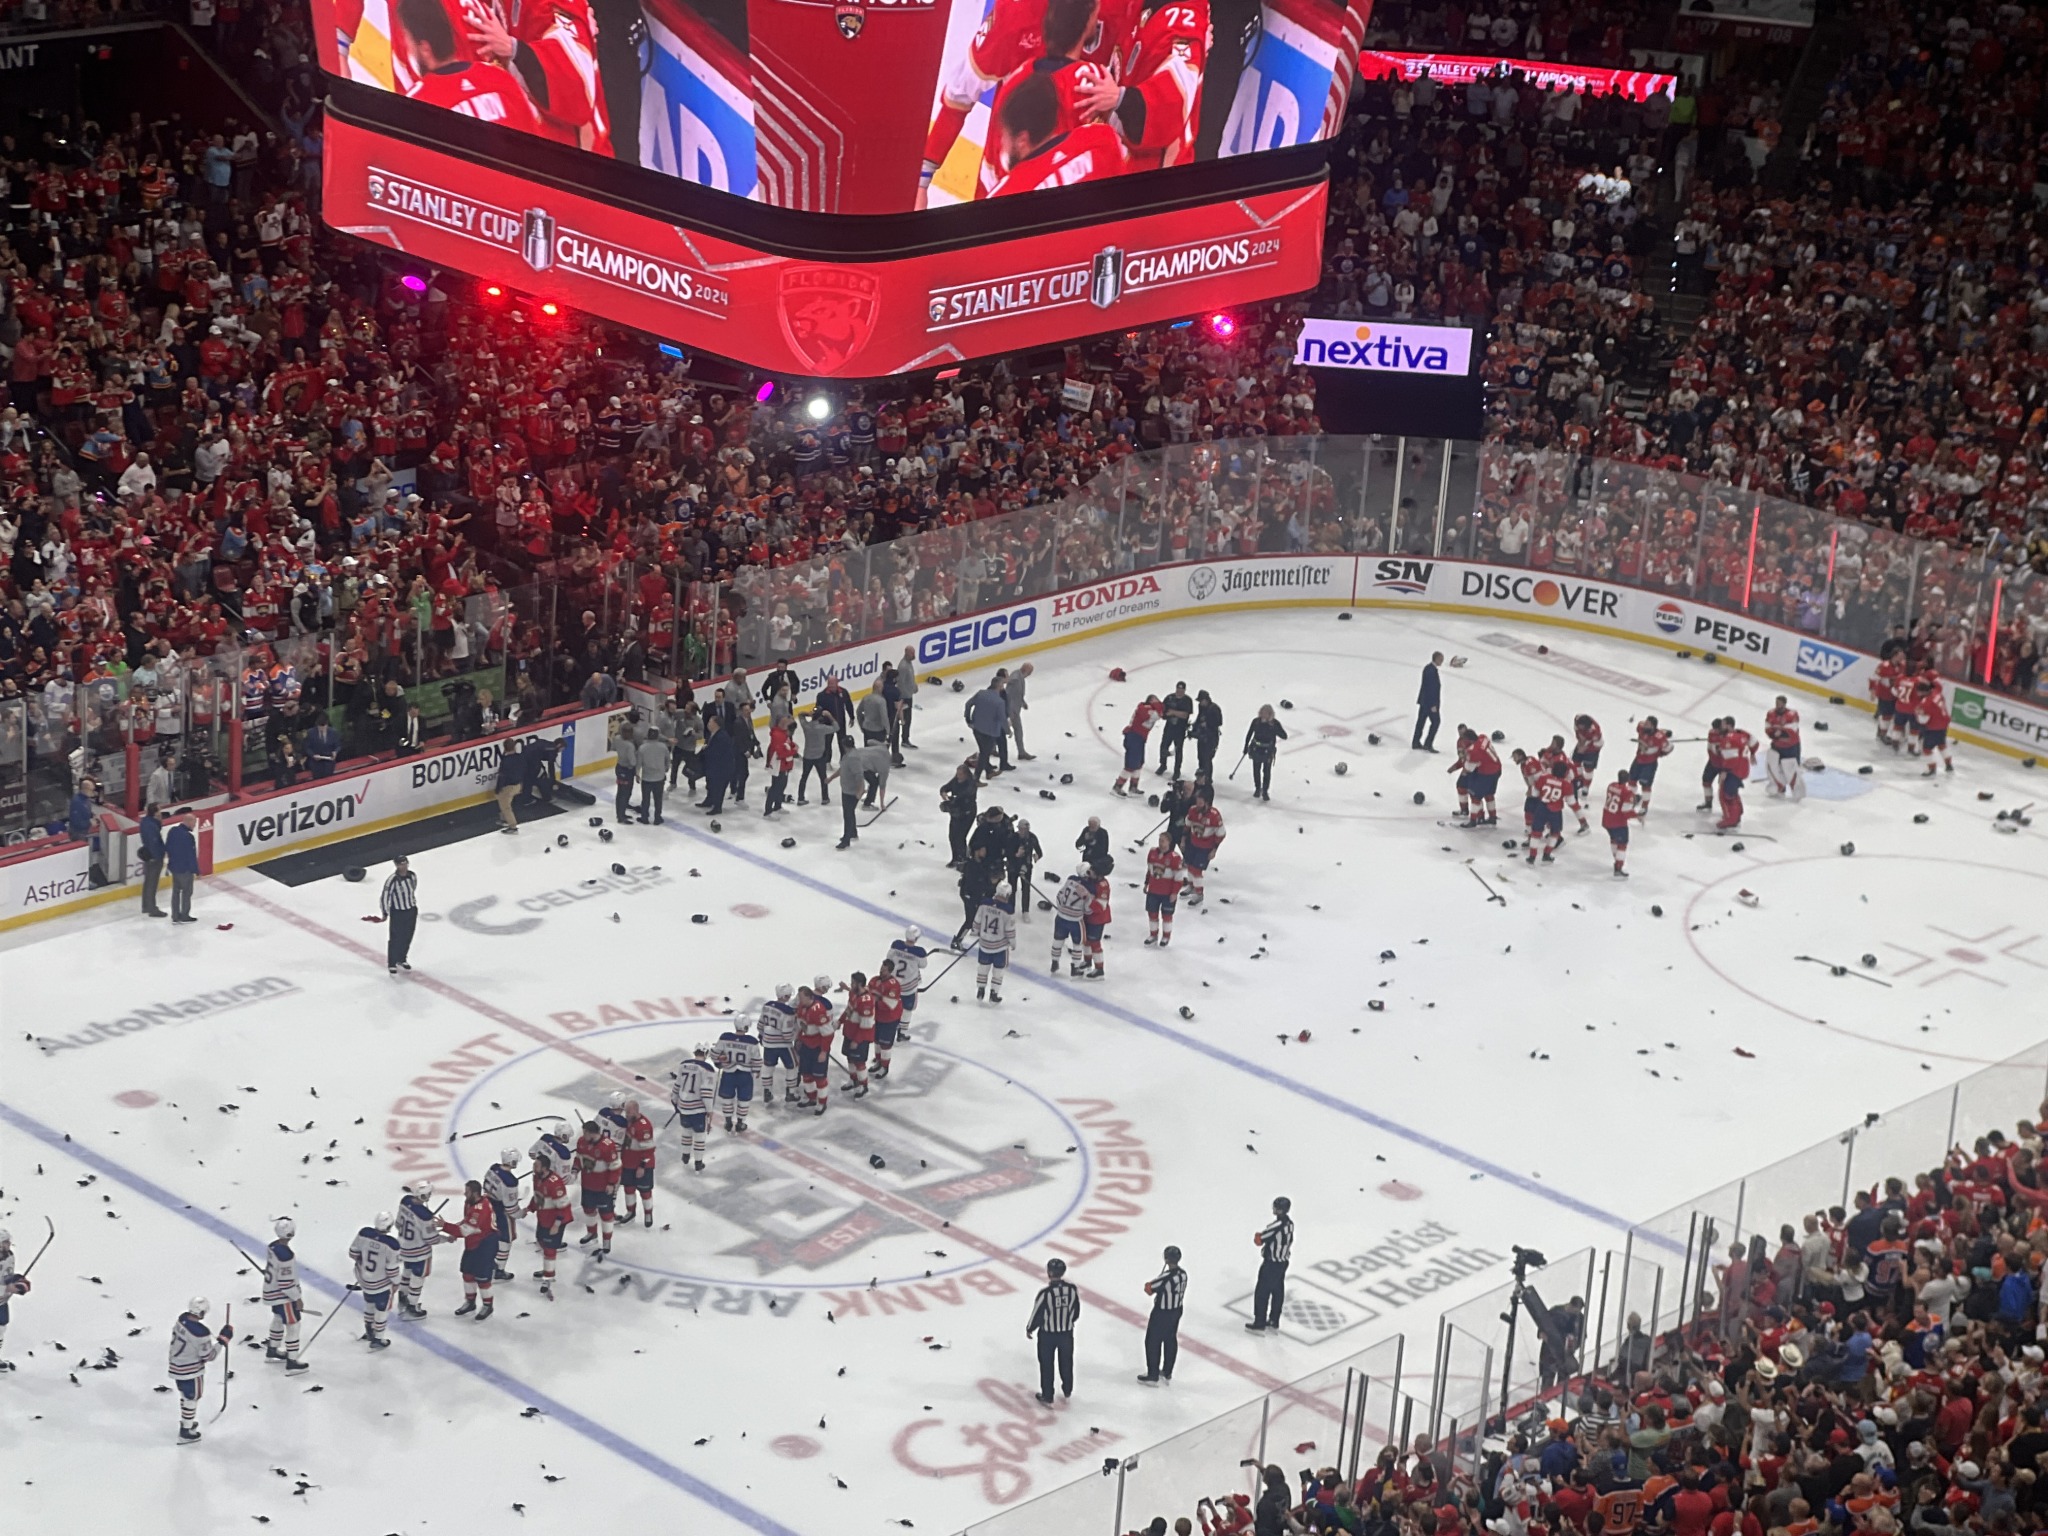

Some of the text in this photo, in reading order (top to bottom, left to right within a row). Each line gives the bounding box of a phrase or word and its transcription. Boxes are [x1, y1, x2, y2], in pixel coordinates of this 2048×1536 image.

[1165, 7, 1196, 27] 72
[388, 184, 728, 306] STANLEY CUP CHAMPIONS 2024
[950, 239, 1280, 320] STANLEY CUP CHAMPIONS 2024
[1303, 335, 1448, 370] nextiva
[1374, 560, 1434, 584] SN
[1052, 575, 1161, 618] HONDA
[1461, 571, 1619, 618] DISCOVER
[1051, 597, 1160, 634] The Power of Dreams
[1655, 611, 1683, 624] PEPSI
[918, 606, 1037, 664] GEICO
[1695, 616, 1770, 655] PEPSI
[1797, 645, 1845, 675] SAP
[238, 791, 356, 845] verizon
[983, 915, 999, 935] 14
[896, 960, 907, 979] 2
[35, 976, 293, 1057] AutoNation
[548, 996, 723, 1033] BANK
[681, 1072, 696, 1093] 71
[942, 1172, 1013, 1198] 1993
[1045, 1098, 1153, 1267] AMERANT
[365, 1250, 378, 1273] 5
[1306, 1218, 1460, 1285] Baptist
[280, 1266, 291, 1276] 25
[573, 1261, 805, 1317] ARENA
[1357, 1246, 1509, 1309] Health
[818, 1269, 1020, 1319] BANK
[1055, 1296, 1068, 1308] 83
[1612, 1501, 1636, 1526] 97
